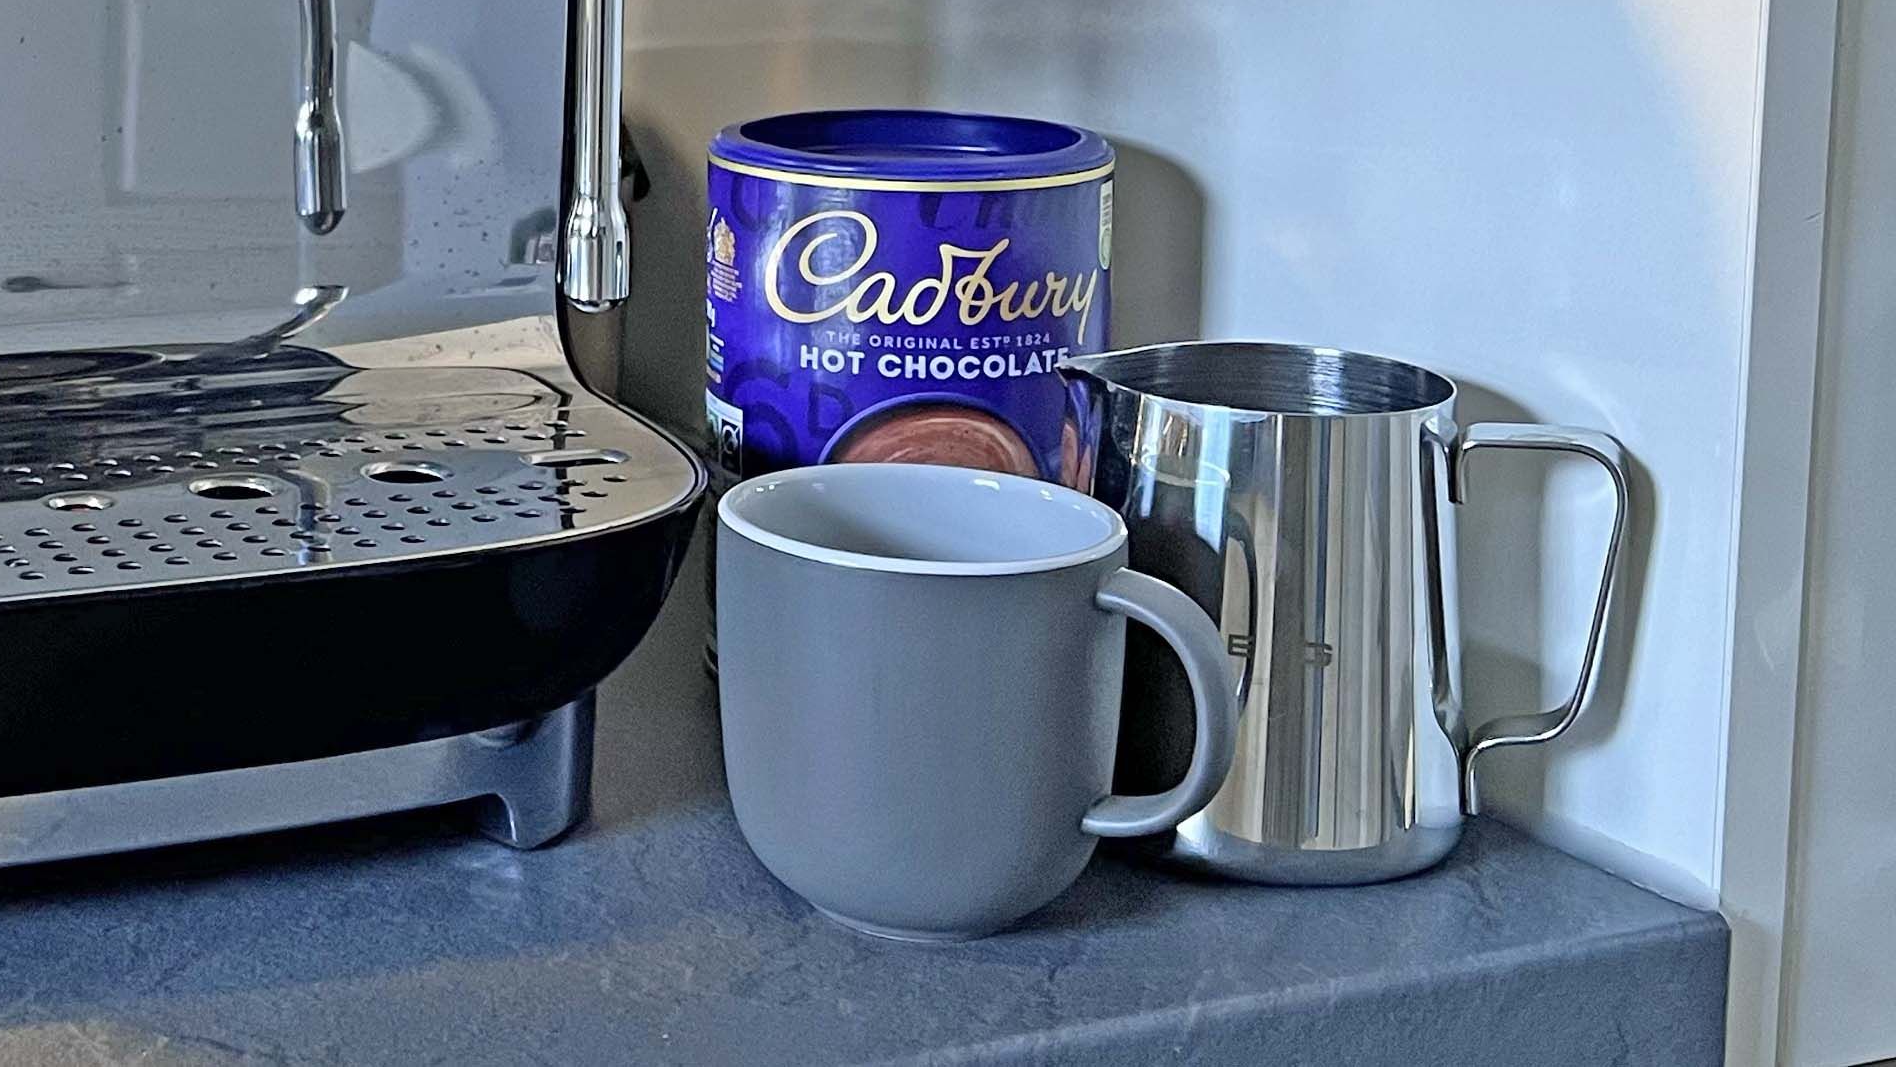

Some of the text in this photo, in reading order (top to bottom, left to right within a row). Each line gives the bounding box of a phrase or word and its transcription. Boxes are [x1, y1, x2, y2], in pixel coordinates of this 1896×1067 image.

[764, 210, 1098, 345] Cadbury
[825, 331, 861, 346] THE
[869, 335, 963, 350] ORIGINAL
[1016, 333, 1051, 347] 1824
[800, 345, 865, 375] HOT
